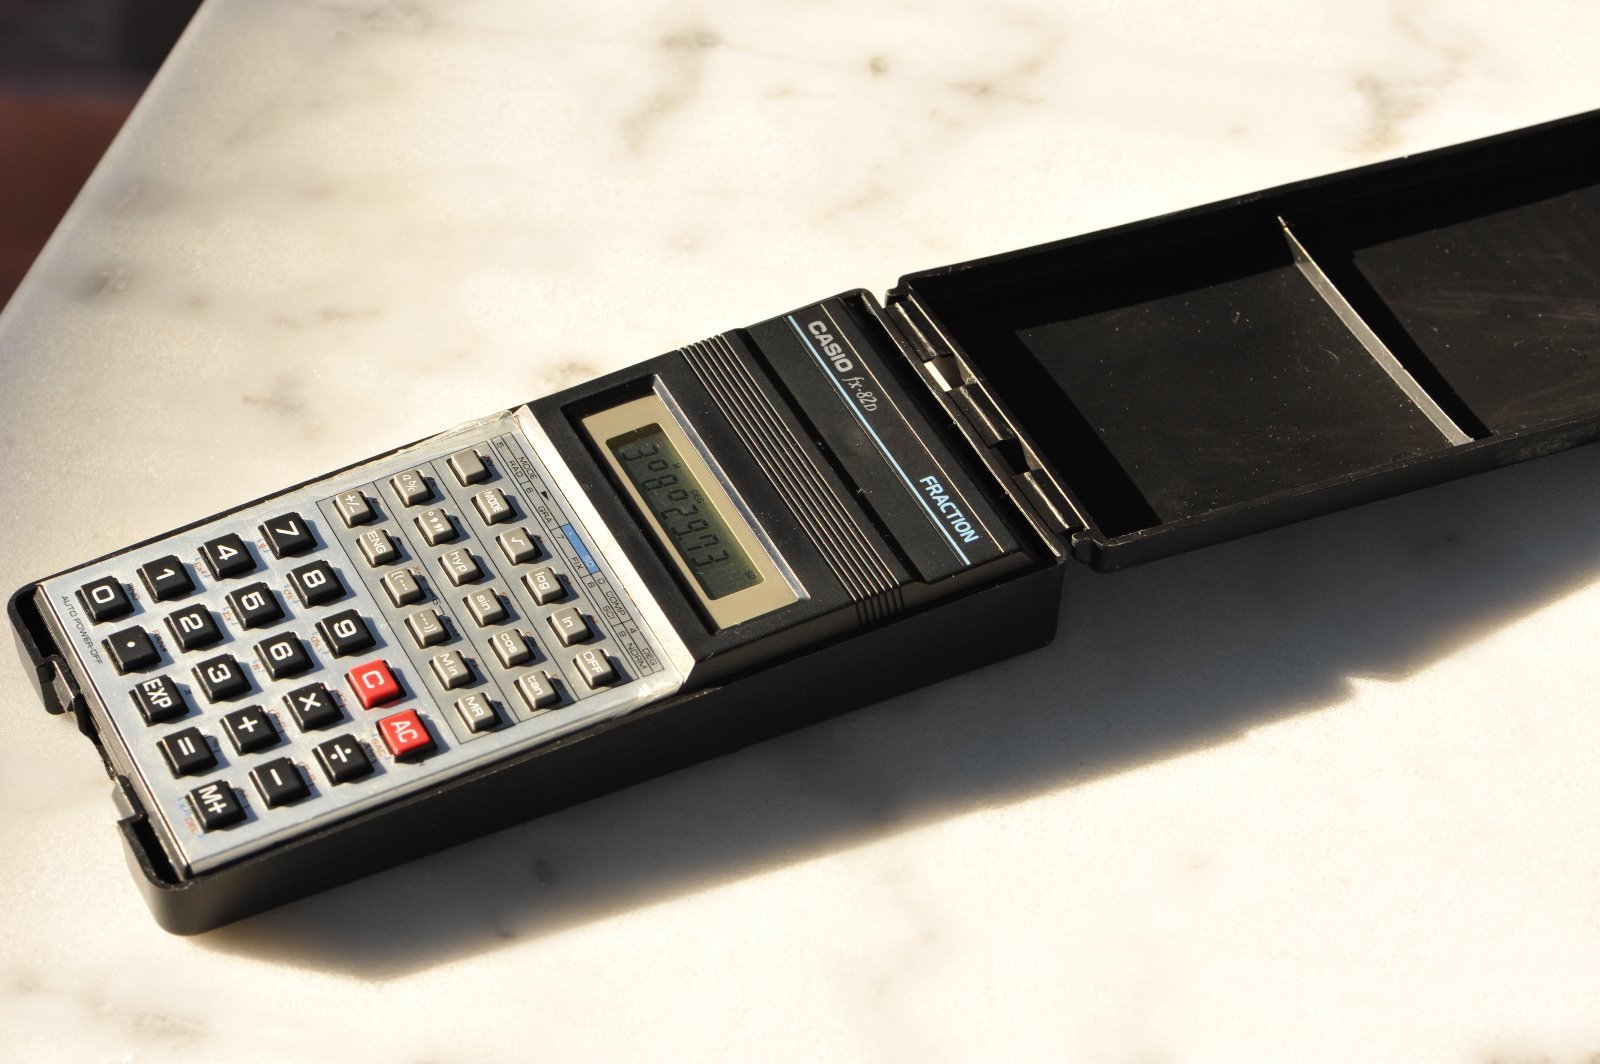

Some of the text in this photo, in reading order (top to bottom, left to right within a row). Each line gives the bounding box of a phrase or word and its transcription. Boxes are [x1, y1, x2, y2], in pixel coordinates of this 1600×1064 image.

[808, 320, 853, 373] CASIO
[508, 460, 524, 478] RAD
[518, 456, 538, 480] MODE
[484, 491, 502, 512] MODE
[691, 490, 704, 504] DEG
[538, 506, 553, 523] GRA
[919, 475, 979, 543] FRACTION
[276, 521, 298, 534] 7
[367, 531, 385, 553] ENG
[218, 545, 237, 559] 4
[450, 551, 466, 571] hyp
[570, 557, 583, 571] FIX
[156, 569, 174, 579] 1
[303, 570, 325, 587] 8
[535, 572, 549, 589] log
[242, 592, 264, 609] 5
[477, 595, 489, 609] sin
[605, 590, 626, 617] COMP
[602, 605, 616, 621] SCI
[62, 596, 103, 665] AUTO POWER-OFF
[180, 614, 202, 631] 2
[334, 620, 355, 637] 9
[270, 642, 292, 659] 6
[501, 633, 516, 652] cos
[583, 651, 602, 672] OFF
[627, 643, 647, 670] NORM
[642, 647, 658, 665] DEG
[208, 664, 230, 682] 3
[362, 671, 383, 687] C
[143, 678, 171, 706] EXP
[528, 676, 542, 695] tan
[466, 697, 483, 716] MR
[391, 721, 417, 742] AC
[199, 785, 226, 812] M+
